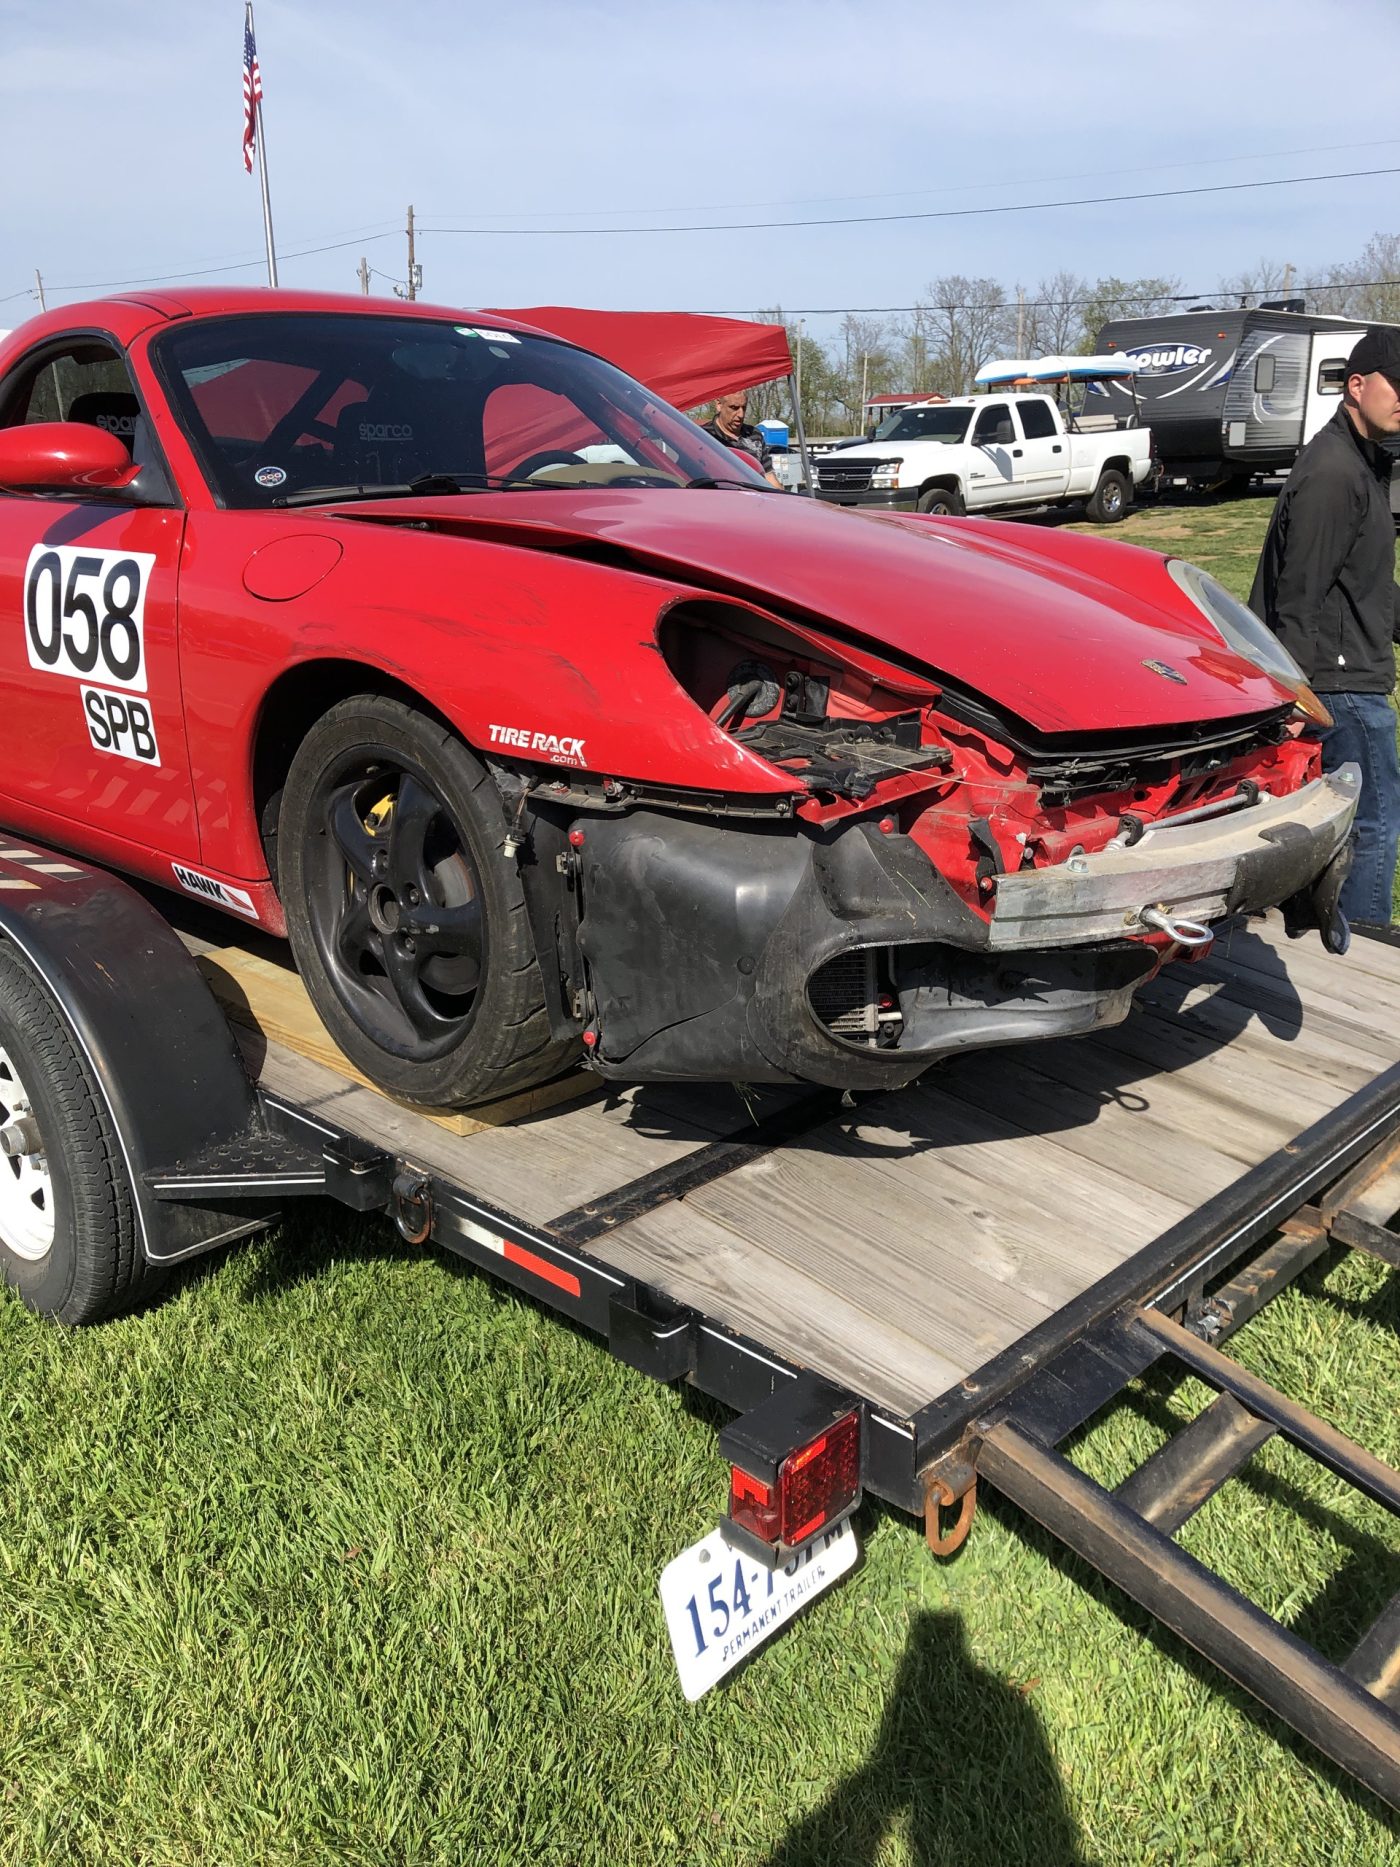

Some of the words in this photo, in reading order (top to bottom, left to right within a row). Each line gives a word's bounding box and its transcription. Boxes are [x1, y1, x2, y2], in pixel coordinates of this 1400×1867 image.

[359, 423, 413, 441] sparco
[27, 551, 140, 681] 058
[85, 690, 156, 760] SPB
[489, 724, 531, 748] TIRE
[531, 732, 587, 767] RACK
[174, 866, 228, 902] HAWK
[722, 1601, 782, 1662] PERMANENT
[784, 1564, 826, 1607] TRAILER
